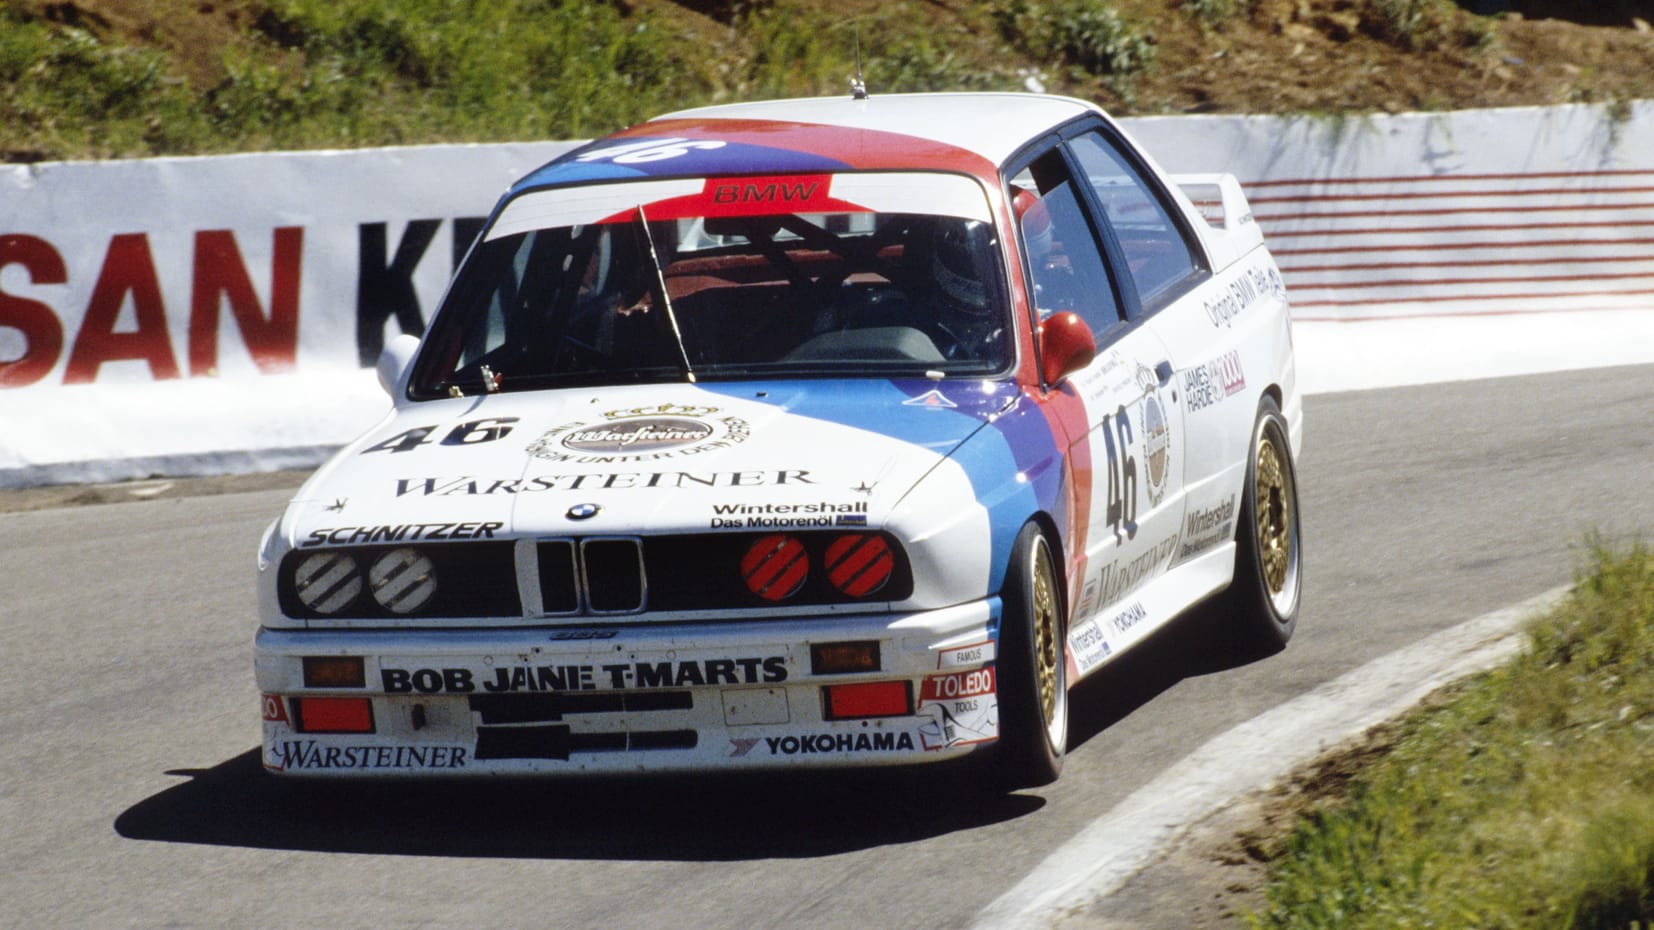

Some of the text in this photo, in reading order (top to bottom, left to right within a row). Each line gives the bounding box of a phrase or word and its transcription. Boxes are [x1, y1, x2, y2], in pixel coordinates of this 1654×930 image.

[576, 137, 727, 163] 46
[713, 183, 818, 205] BMW
[357, 217, 499, 369] K
[1230, 272, 1256, 310] BMW
[1184, 364, 1209, 392] JAMES
[1186, 384, 1214, 414] HARDIE
[359, 416, 521, 456] 46
[396, 469, 818, 498] WARSTEINER
[1102, 404, 1138, 547] 46
[711, 517, 743, 529] Das
[747, 515, 832, 528] Motorenöl
[712, 501, 868, 515] Wintershall
[1187, 493, 1235, 538] Wintershall
[303, 521, 504, 546] SCHNITZER
[957, 648, 982, 663] FAMOUS
[380, 656, 788, 694] BOB JANE T-MARTS
[933, 669, 991, 697] TOLEDO
[955, 701, 979, 713] TOOLS
[283, 740, 467, 769] WARSTEINER
[766, 731, 915, 755] YOKOHAMA
